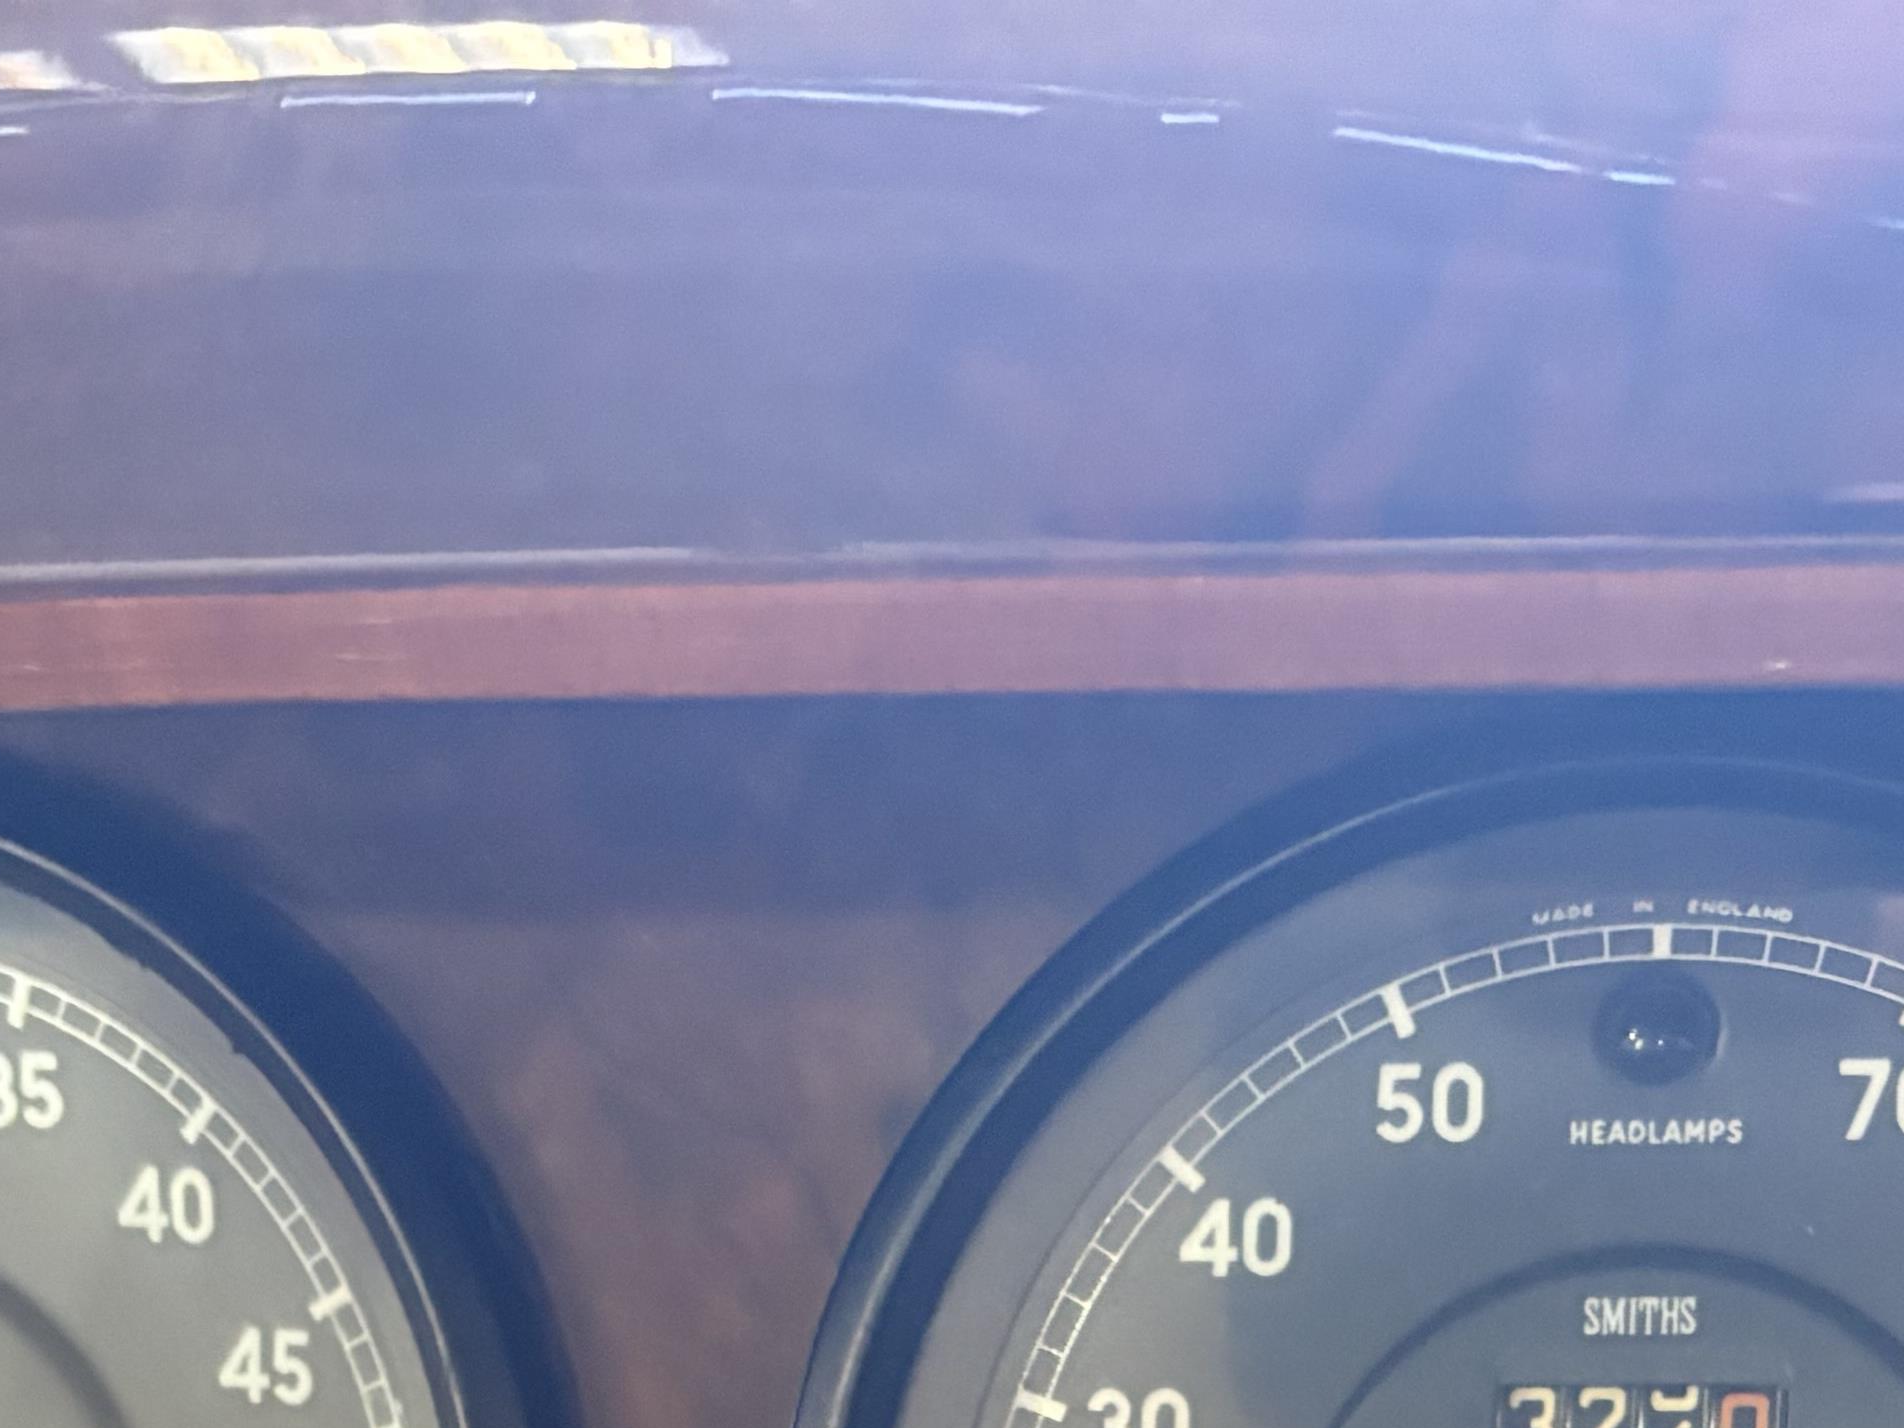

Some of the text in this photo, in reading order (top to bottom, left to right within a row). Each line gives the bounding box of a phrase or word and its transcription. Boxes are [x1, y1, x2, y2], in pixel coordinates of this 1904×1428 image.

[1687, 898, 1794, 925] ENGLAND
[1375, 1062, 1485, 1143] 50
[1569, 1119, 1744, 1145] HEADLAMPS
[117, 1164, 215, 1244] 40
[1179, 1197, 1292, 1277] 40
[1583, 1296, 1697, 1336] SMITHS
[218, 1326, 313, 1405] 45
